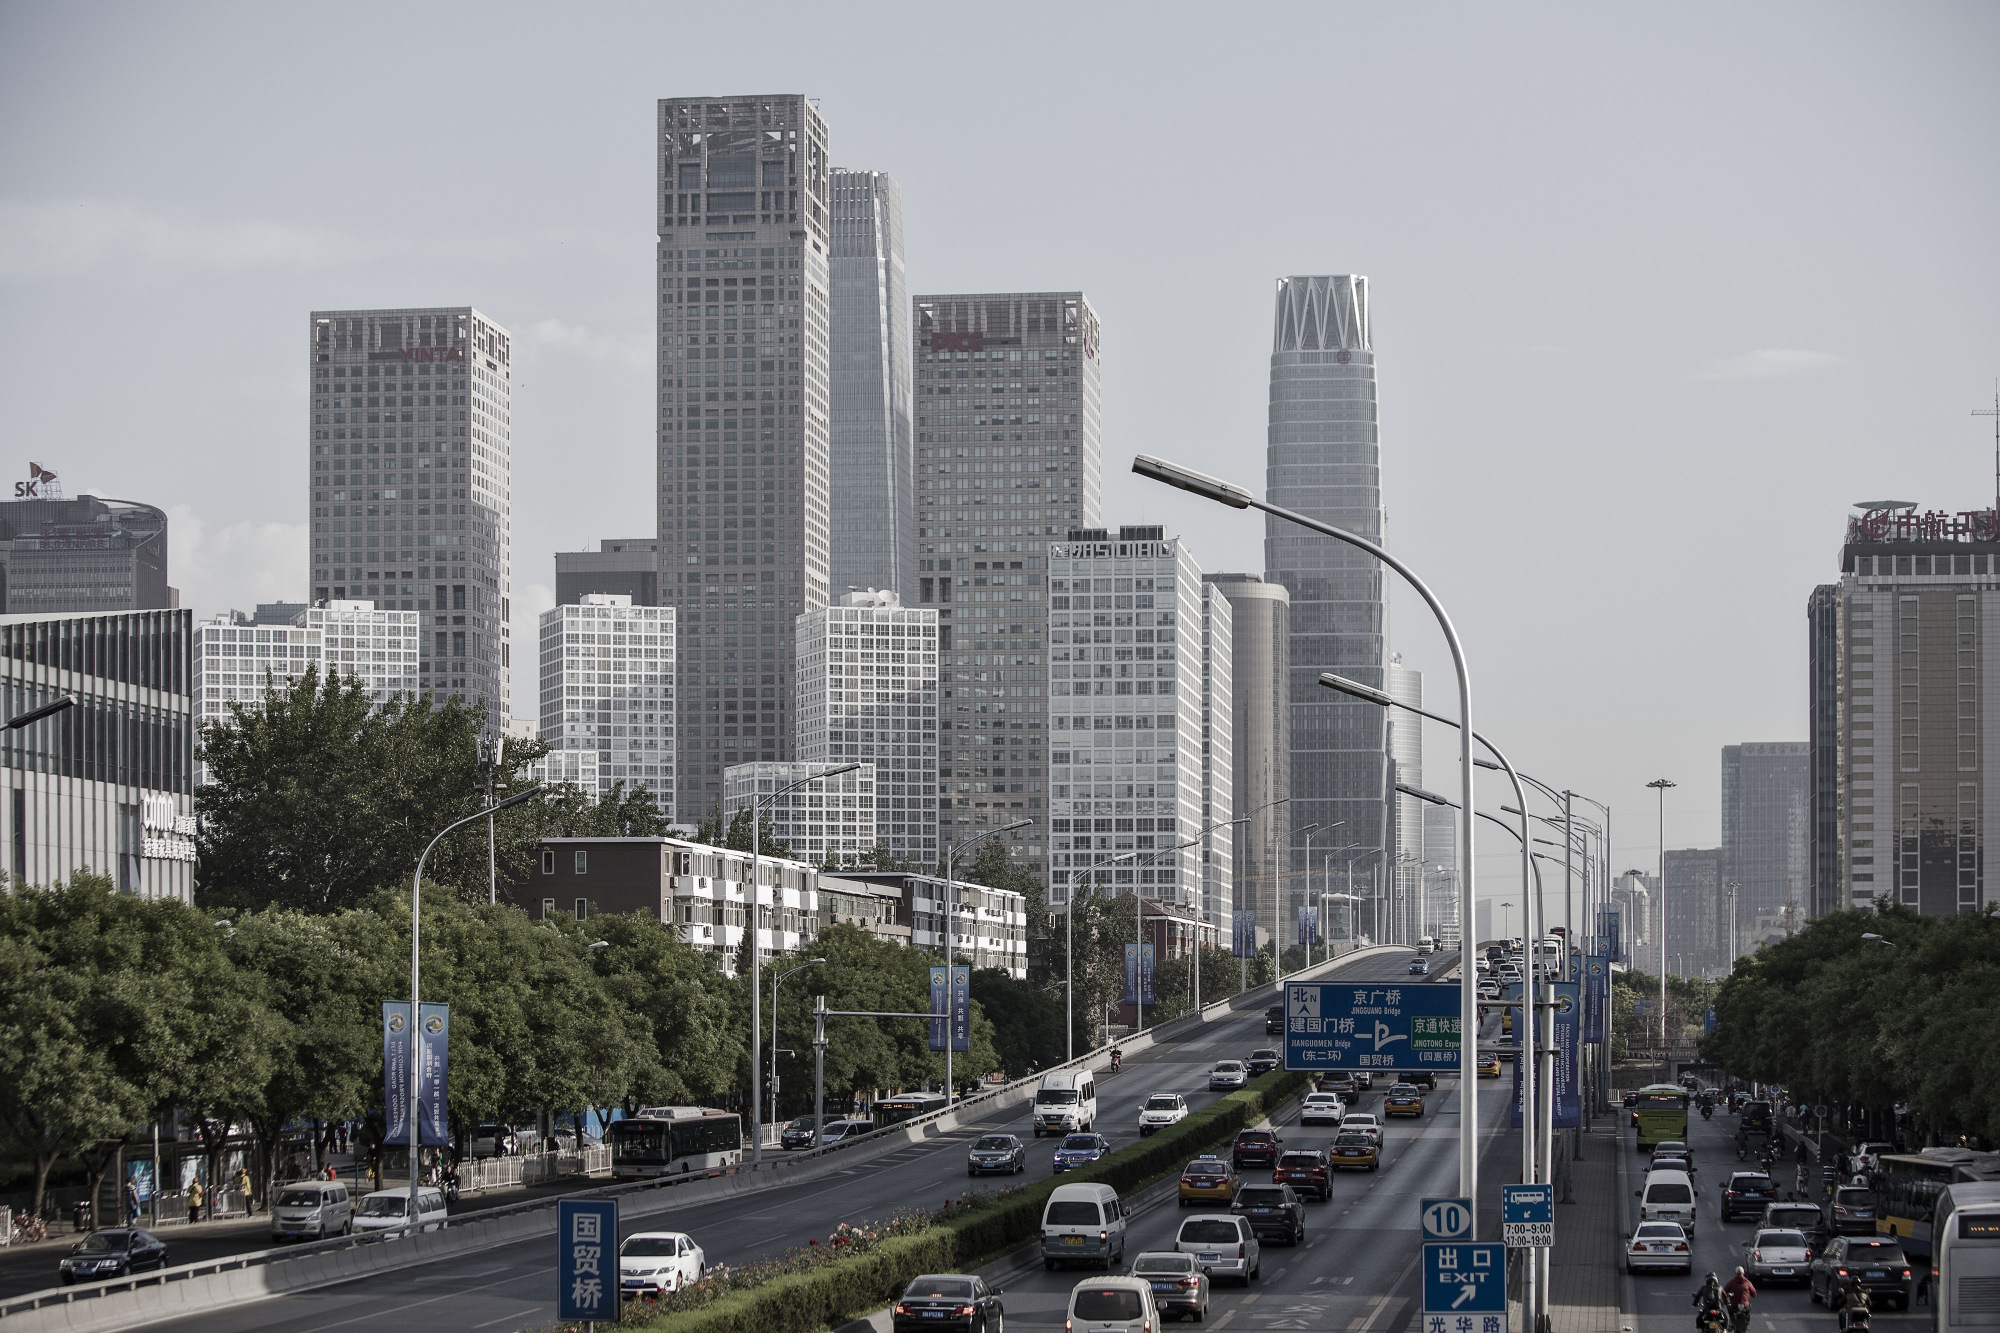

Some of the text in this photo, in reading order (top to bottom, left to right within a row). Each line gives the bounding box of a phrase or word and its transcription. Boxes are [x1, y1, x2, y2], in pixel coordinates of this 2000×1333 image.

[932, 332, 983, 352] PICC
[399, 346, 466, 363] YINTAI
[15, 481, 38, 497] SK
[1293, 988, 1317, 1002] 北 N
[1353, 989, 1401, 1005] 京广桥
[1351, 1007, 1401, 1016] JINGGUANG Bridge
[1290, 1017, 1355, 1034] 建国门桥
[1414, 1018, 1461, 1034] 京通快速
[1291, 1040, 1351, 1049] JIANGUOMEN Bridge
[1413, 1040, 1443, 1048] JINGTONG
[1302, 1050, 1342, 1061] (东二环)
[1360, 1054, 1395, 1066] 国贸桥
[1419, 1051, 1457, 1062] (四惠桥)
[1432, 1206, 1460, 1233] 10
[1506, 1224, 1551, 1234] 7:00-9:00
[1507, 1235, 1552, 1246] 17:00-19:00
[571, 1212, 603, 1309] 国贸桥
[1438, 1247, 1491, 1269] 出口
[1439, 1272, 1490, 1283] EXIT
[1429, 1316, 1501, 1333] 光华路
